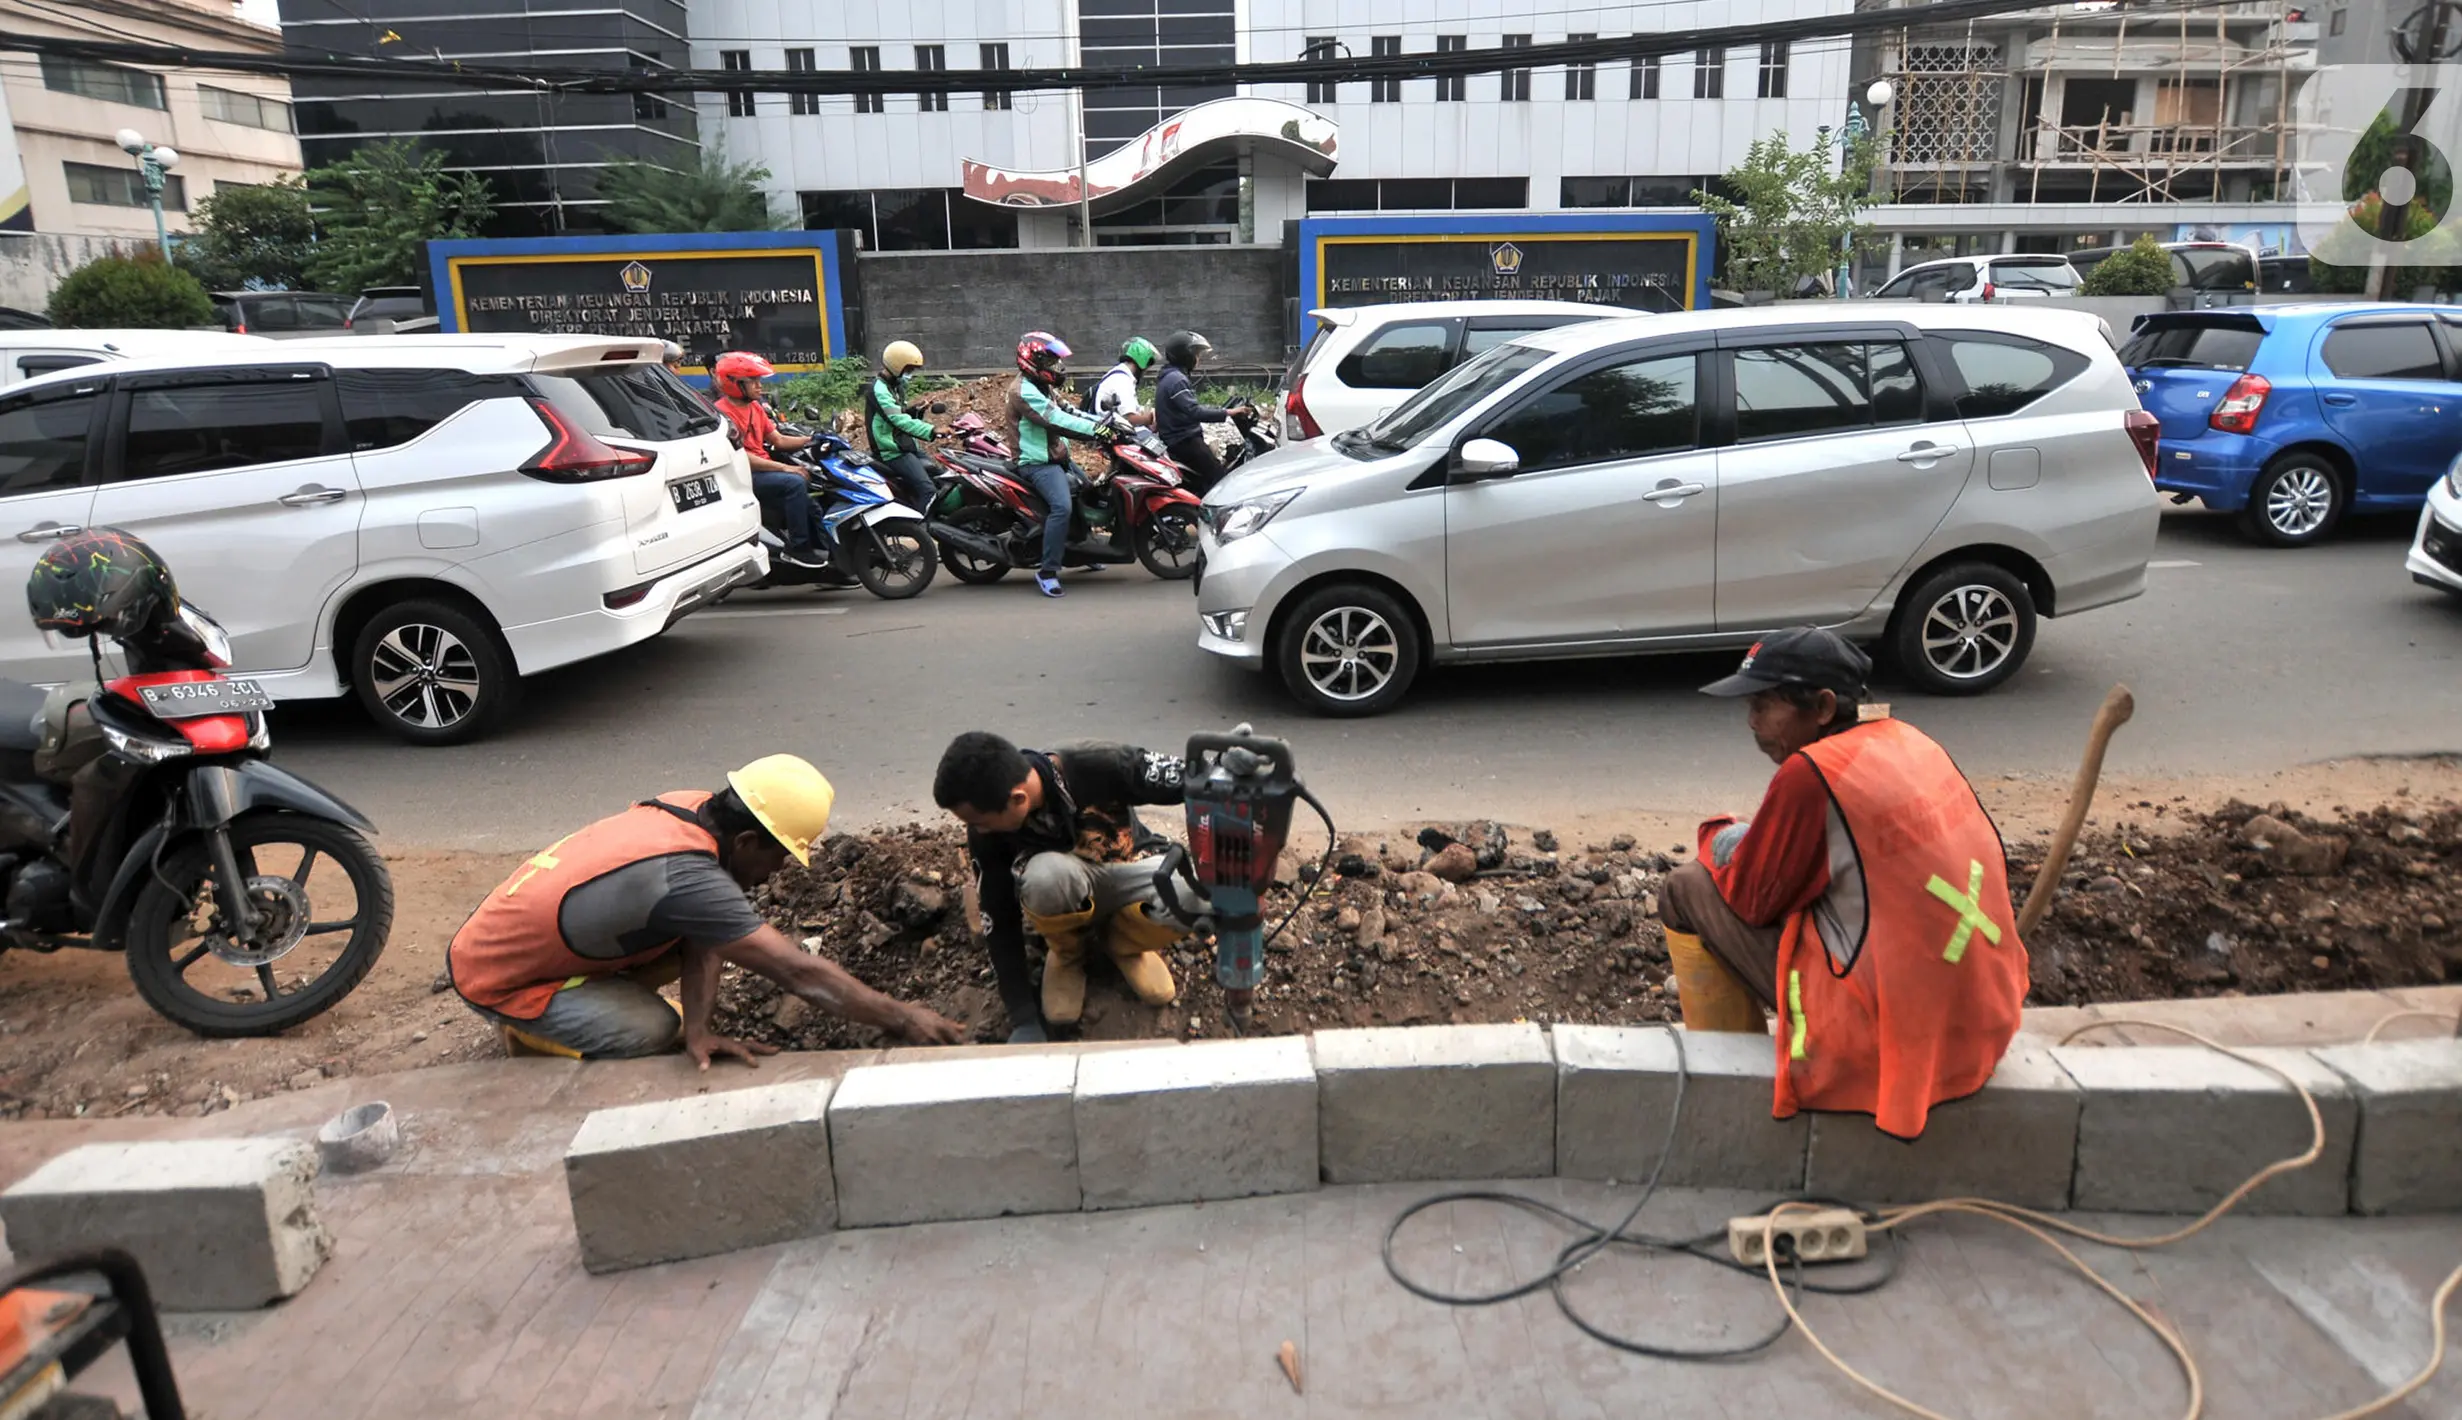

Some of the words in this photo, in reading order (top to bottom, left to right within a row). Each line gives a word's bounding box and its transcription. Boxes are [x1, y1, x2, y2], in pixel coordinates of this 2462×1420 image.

[1332, 277, 1433, 291] KEMENTERIAN
[1443, 275, 1520, 290] KEUANGAN
[1531, 274, 1599, 289] REPUBLIK
[1607, 273, 1680, 288] INDONESIA
[470, 294, 567, 311] KEMENTERIAN
[576, 292, 651, 308] KEUANGAN
[661, 291, 730, 306] REPUBLIK
[740, 289, 812, 304] INDONESIA
[1577, 288, 1622, 302] PAJAK
[530, 308, 617, 323] DIREKTORAT
[628, 305, 700, 322] JENDERAL
[708, 304, 756, 320] PAJAK
[590, 322, 656, 336] PRATAMA
[664, 320, 731, 335] JAKARTA
[785, 352, 817, 363] 12810
[671, 486, 681, 504] B
[143, 688, 158, 702] B
[171, 684, 219, 700] 6346
[227, 682, 261, 696] ZCL
